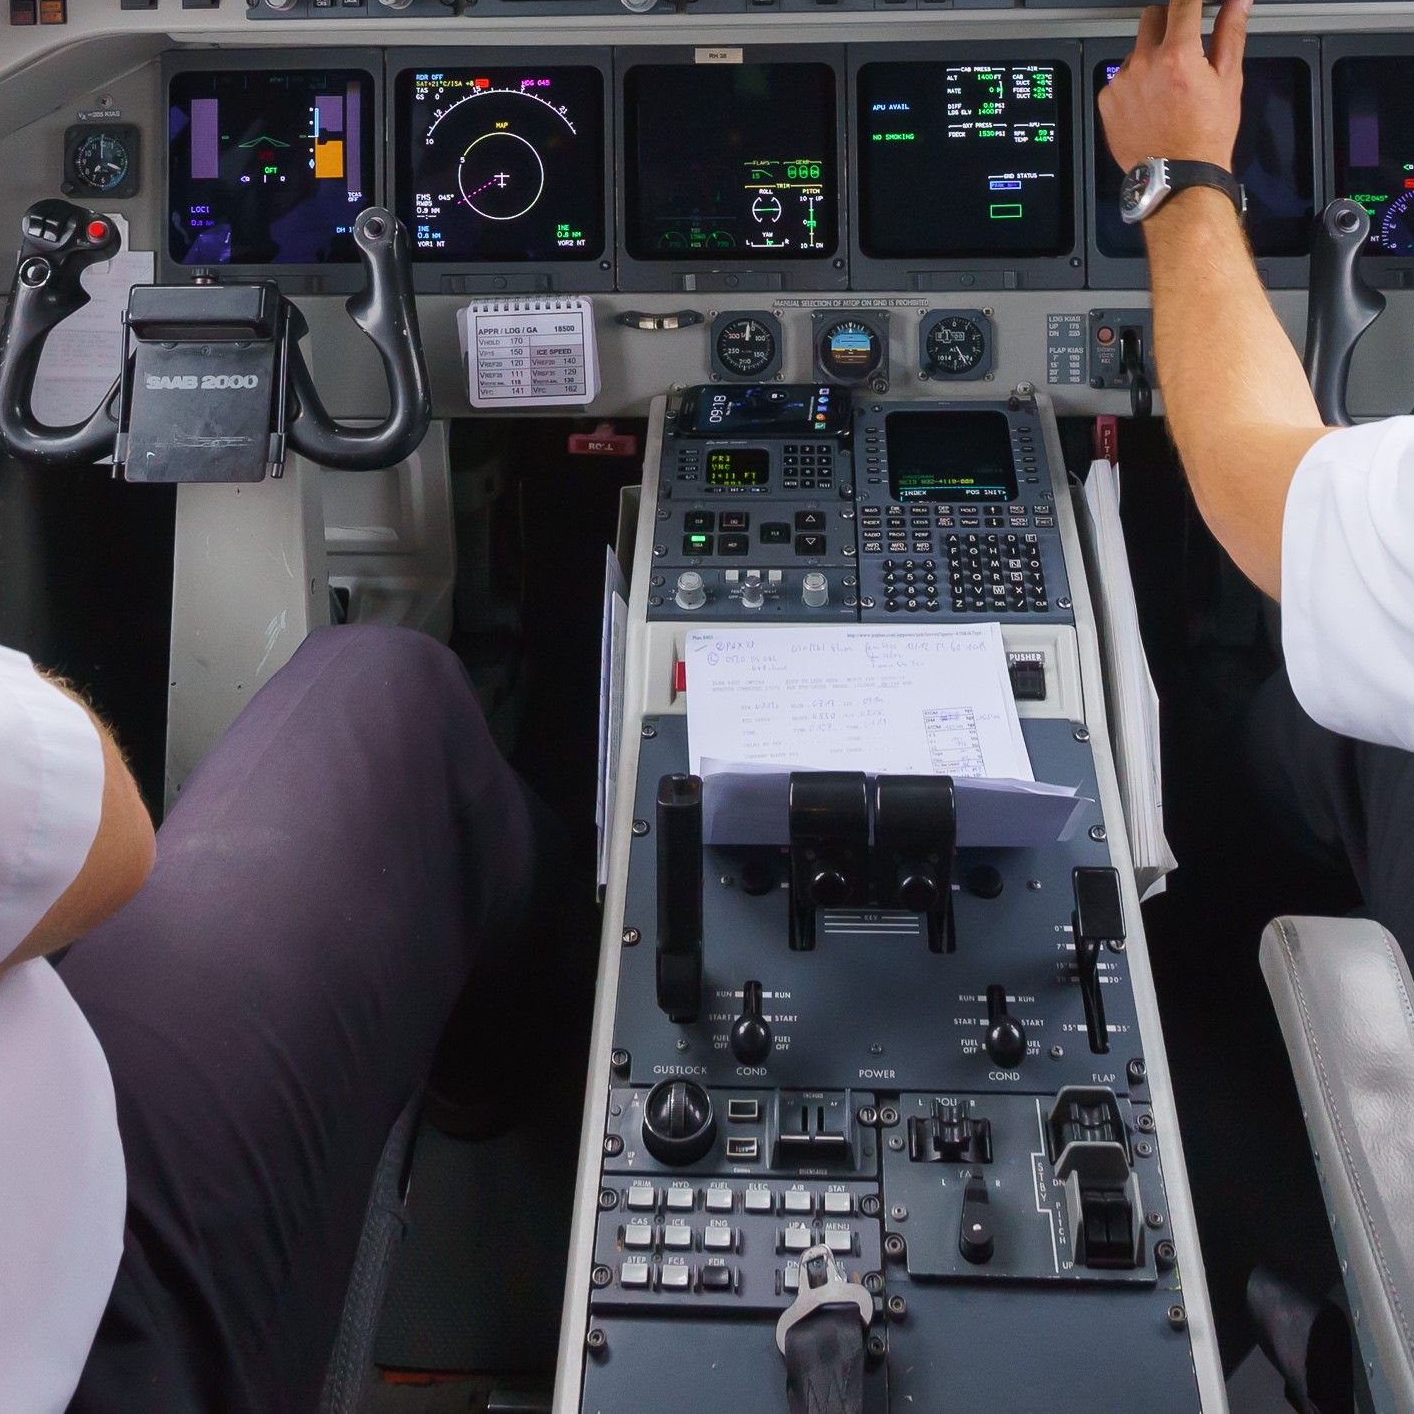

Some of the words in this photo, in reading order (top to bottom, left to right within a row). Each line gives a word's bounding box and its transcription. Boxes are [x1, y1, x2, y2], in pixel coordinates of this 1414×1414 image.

[146, 375, 199, 390] SAAB
[201, 374, 259, 389] 2000
[1009, 652, 1043, 662] PUSHER
[774, 1035, 791, 1043] FUEL
[653, 1065, 708, 1075] GUSTLOCK
[736, 1066, 767, 1076] COND
[858, 1069, 896, 1079] POWER
[988, 1072, 1020, 1081] COND
[1092, 1073, 1116, 1082] FLAP
[749, 1183, 768, 1191] ELEC
[792, 1184, 805, 1192] AIR
[631, 1217, 648, 1225] CAS
[825, 1223, 850, 1231] MENU
[627, 1255, 647, 1263] STEP
[668, 1257, 685, 1265] FCS
[1062, 1261, 1074, 1270] UP
